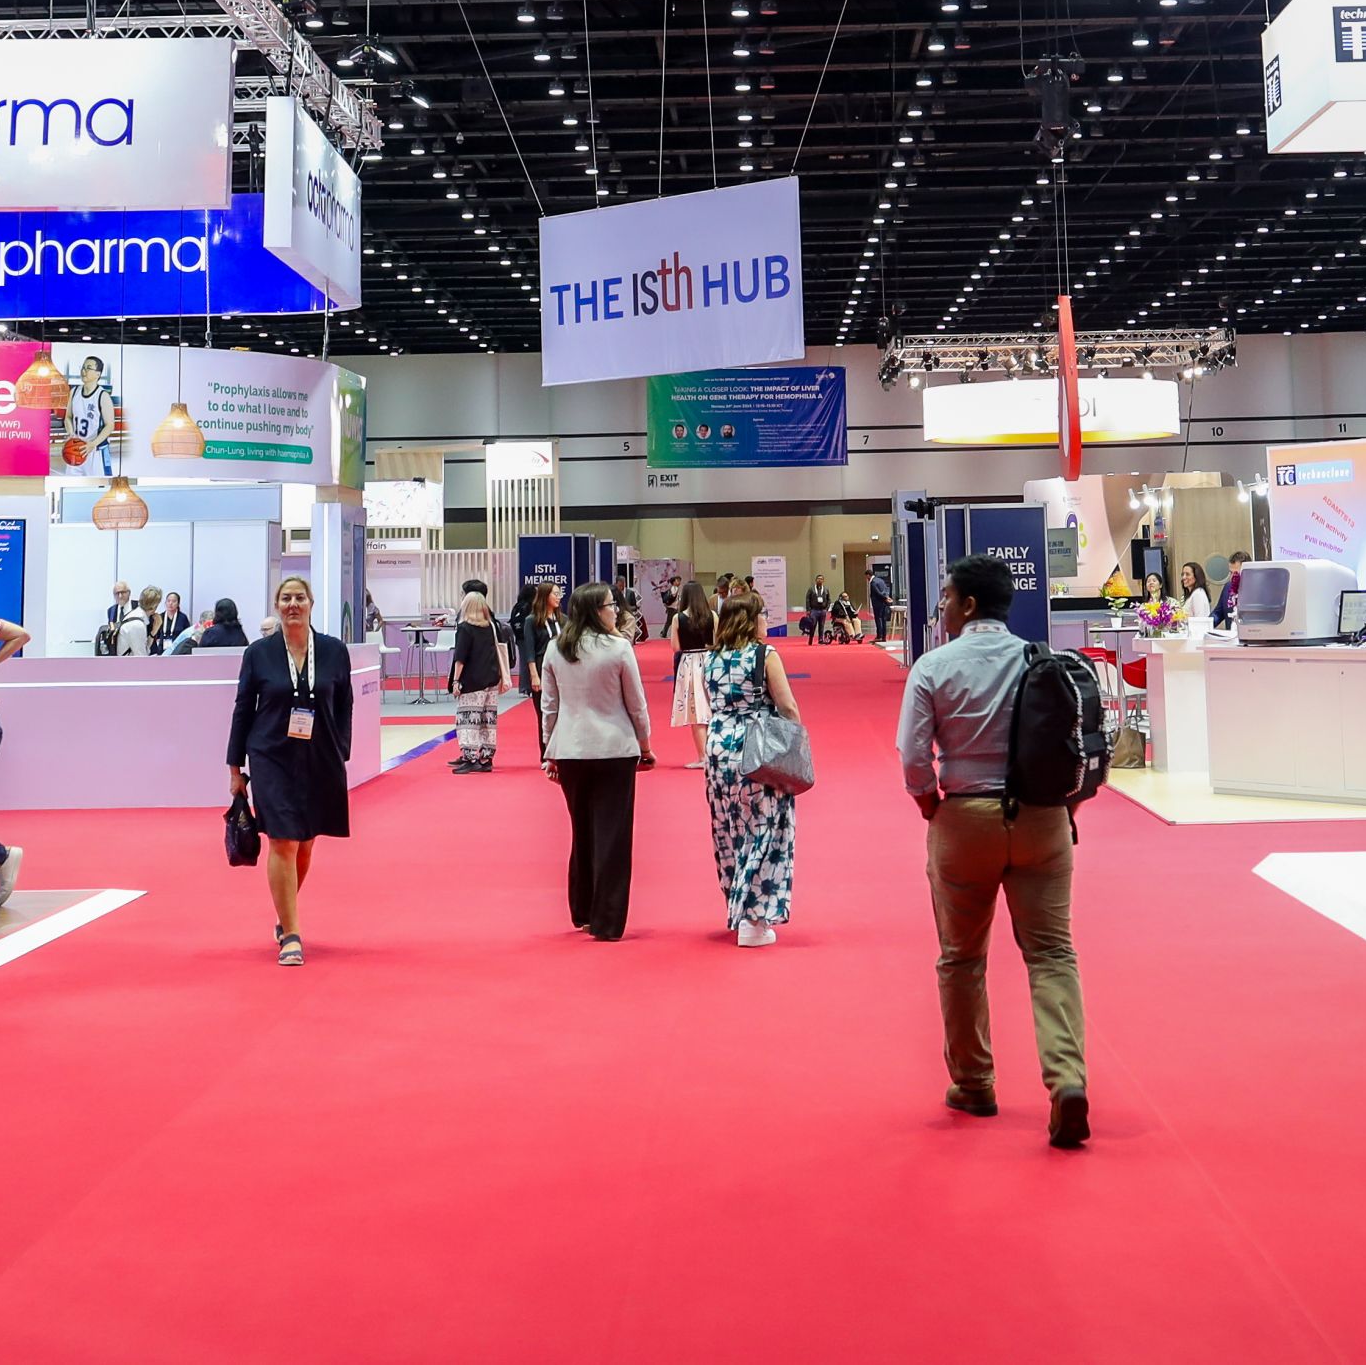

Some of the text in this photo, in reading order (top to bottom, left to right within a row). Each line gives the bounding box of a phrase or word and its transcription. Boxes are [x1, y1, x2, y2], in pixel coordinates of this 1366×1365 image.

[306, 168, 355, 252] octapharma
[549, 253, 792, 327] THE HUB
[272, 387, 309, 402] allows me
[208, 400, 309, 419] to do what I love and to
[74, 416, 90, 438] 13
[196, 418, 295, 437] continue pushing my
[1211, 427, 1224, 437] 10
[1338, 423, 1348, 433] 11
[8, 430, 32, 441] (FVIII)
[862, 435, 870, 445] 7
[205, 445, 245, 457] Chun-Lung,
[246, 446, 264, 457] living
[265, 447, 277, 457] with
[304, 451, 310, 459] A
[623, 441, 631, 452] 5
[660, 474, 678, 482] EXIT
[1277, 469, 1295, 486] TC
[1322, 495, 1355, 529] ADAMTS13
[1325, 521, 1348, 543] activity
[986, 546, 1030, 560] EARLY
[1278, 546, 1307, 560] Thrombin
[376, 558, 397, 567] Meeting
[534, 564, 557, 574] ISTH
[524, 574, 568, 585] MEMBER
